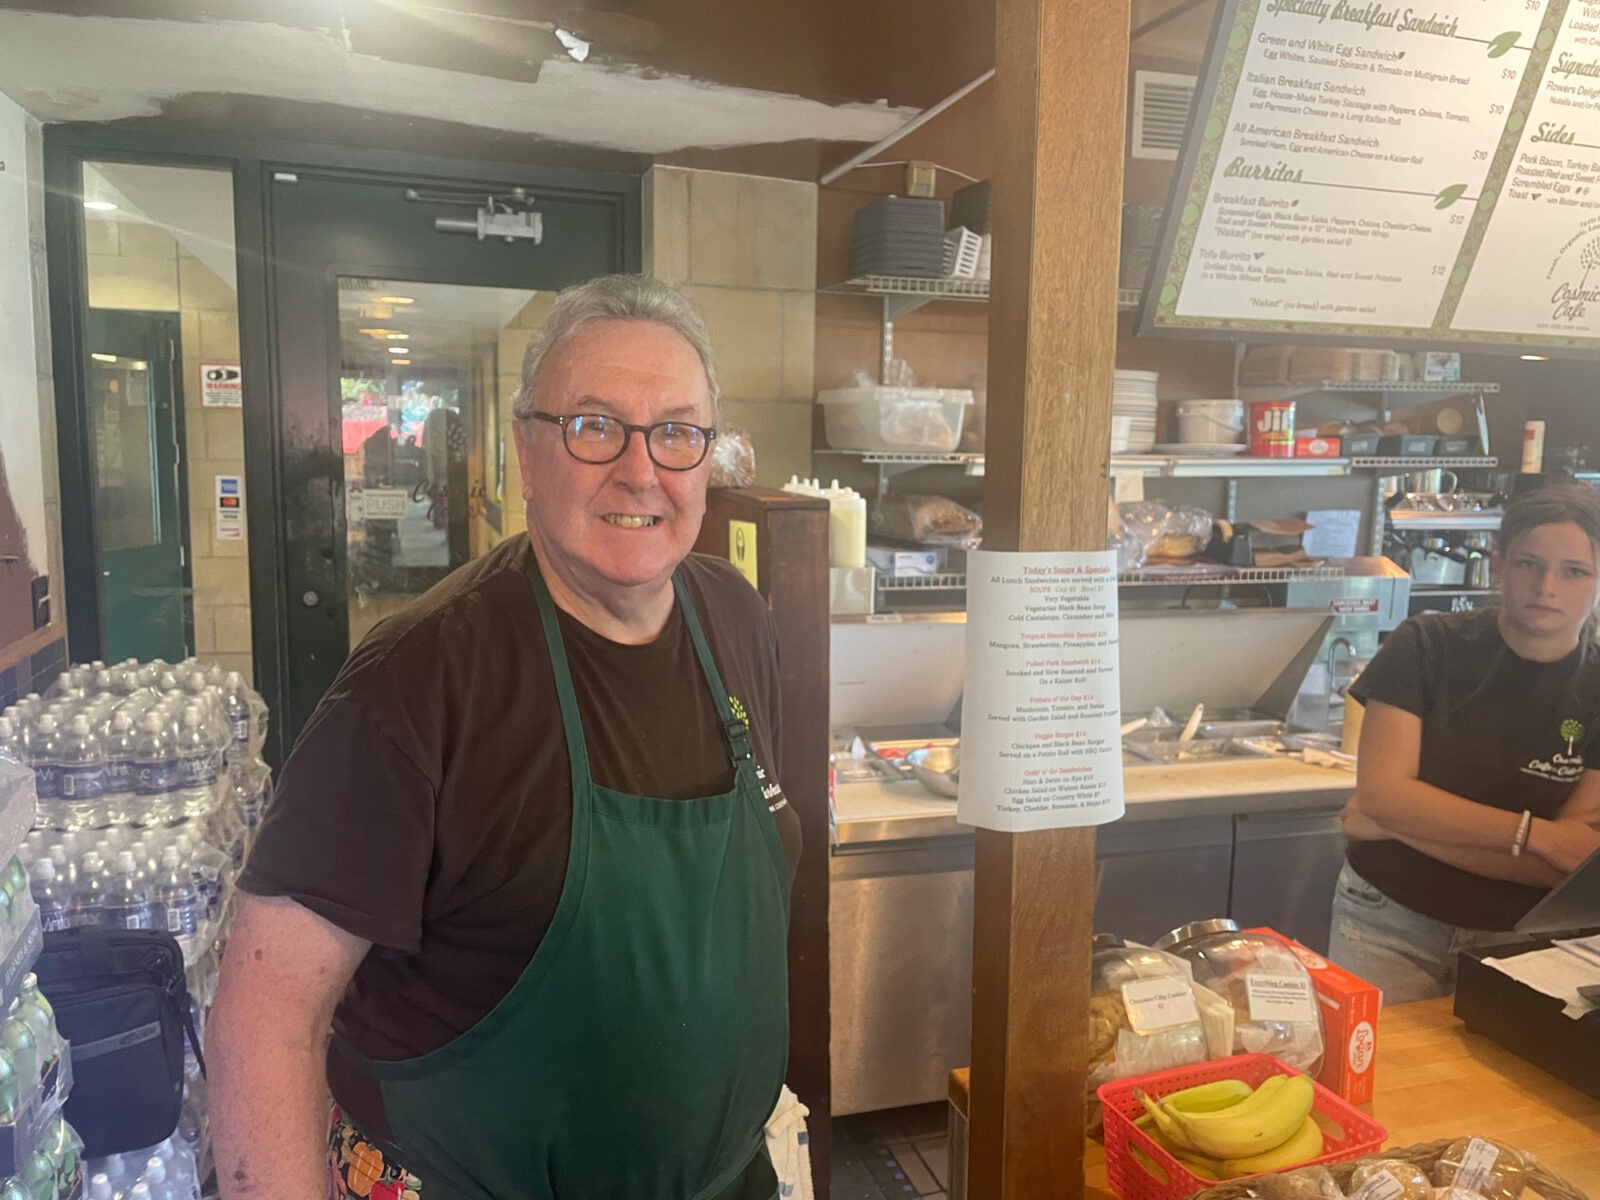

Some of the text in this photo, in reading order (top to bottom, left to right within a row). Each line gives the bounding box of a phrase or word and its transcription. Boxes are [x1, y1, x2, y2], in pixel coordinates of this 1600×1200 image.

[1330, 0, 1399, 31] Breakfast
[1397, 8, 1458, 38] Sandwich
[1258, 32, 1397, 62] Green and White Egg Sandwich
[1264, 48, 1278, 60] Egg
[1378, 64, 1402, 76] Tomato
[1449, 74, 1470, 85] Bread
[1501, 68, 1516, 80] $10
[1246, 72, 1366, 96] Italian Breakfast Sandwich
[1264, 102, 1300, 114] Parmesan
[1303, 106, 1328, 117] Cheese
[1346, 112, 1363, 123] Long
[1489, 104, 1504, 115] $10
[1233, 122, 1380, 148] All American Breakfast Sandwich
[1530, 122, 1576, 145] Sides
[1473, 150, 1488, 160] $10
[1223, 156, 1304, 182] Burritos
[1512, 176, 1571, 194] Scrambled Eggs
[1258, 197, 1290, 208] Burrito
[1551, 282, 1600, 304] Cosmic
[1552, 300, 1586, 321] Cafe
[366, 498, 406, 512] PUSH
